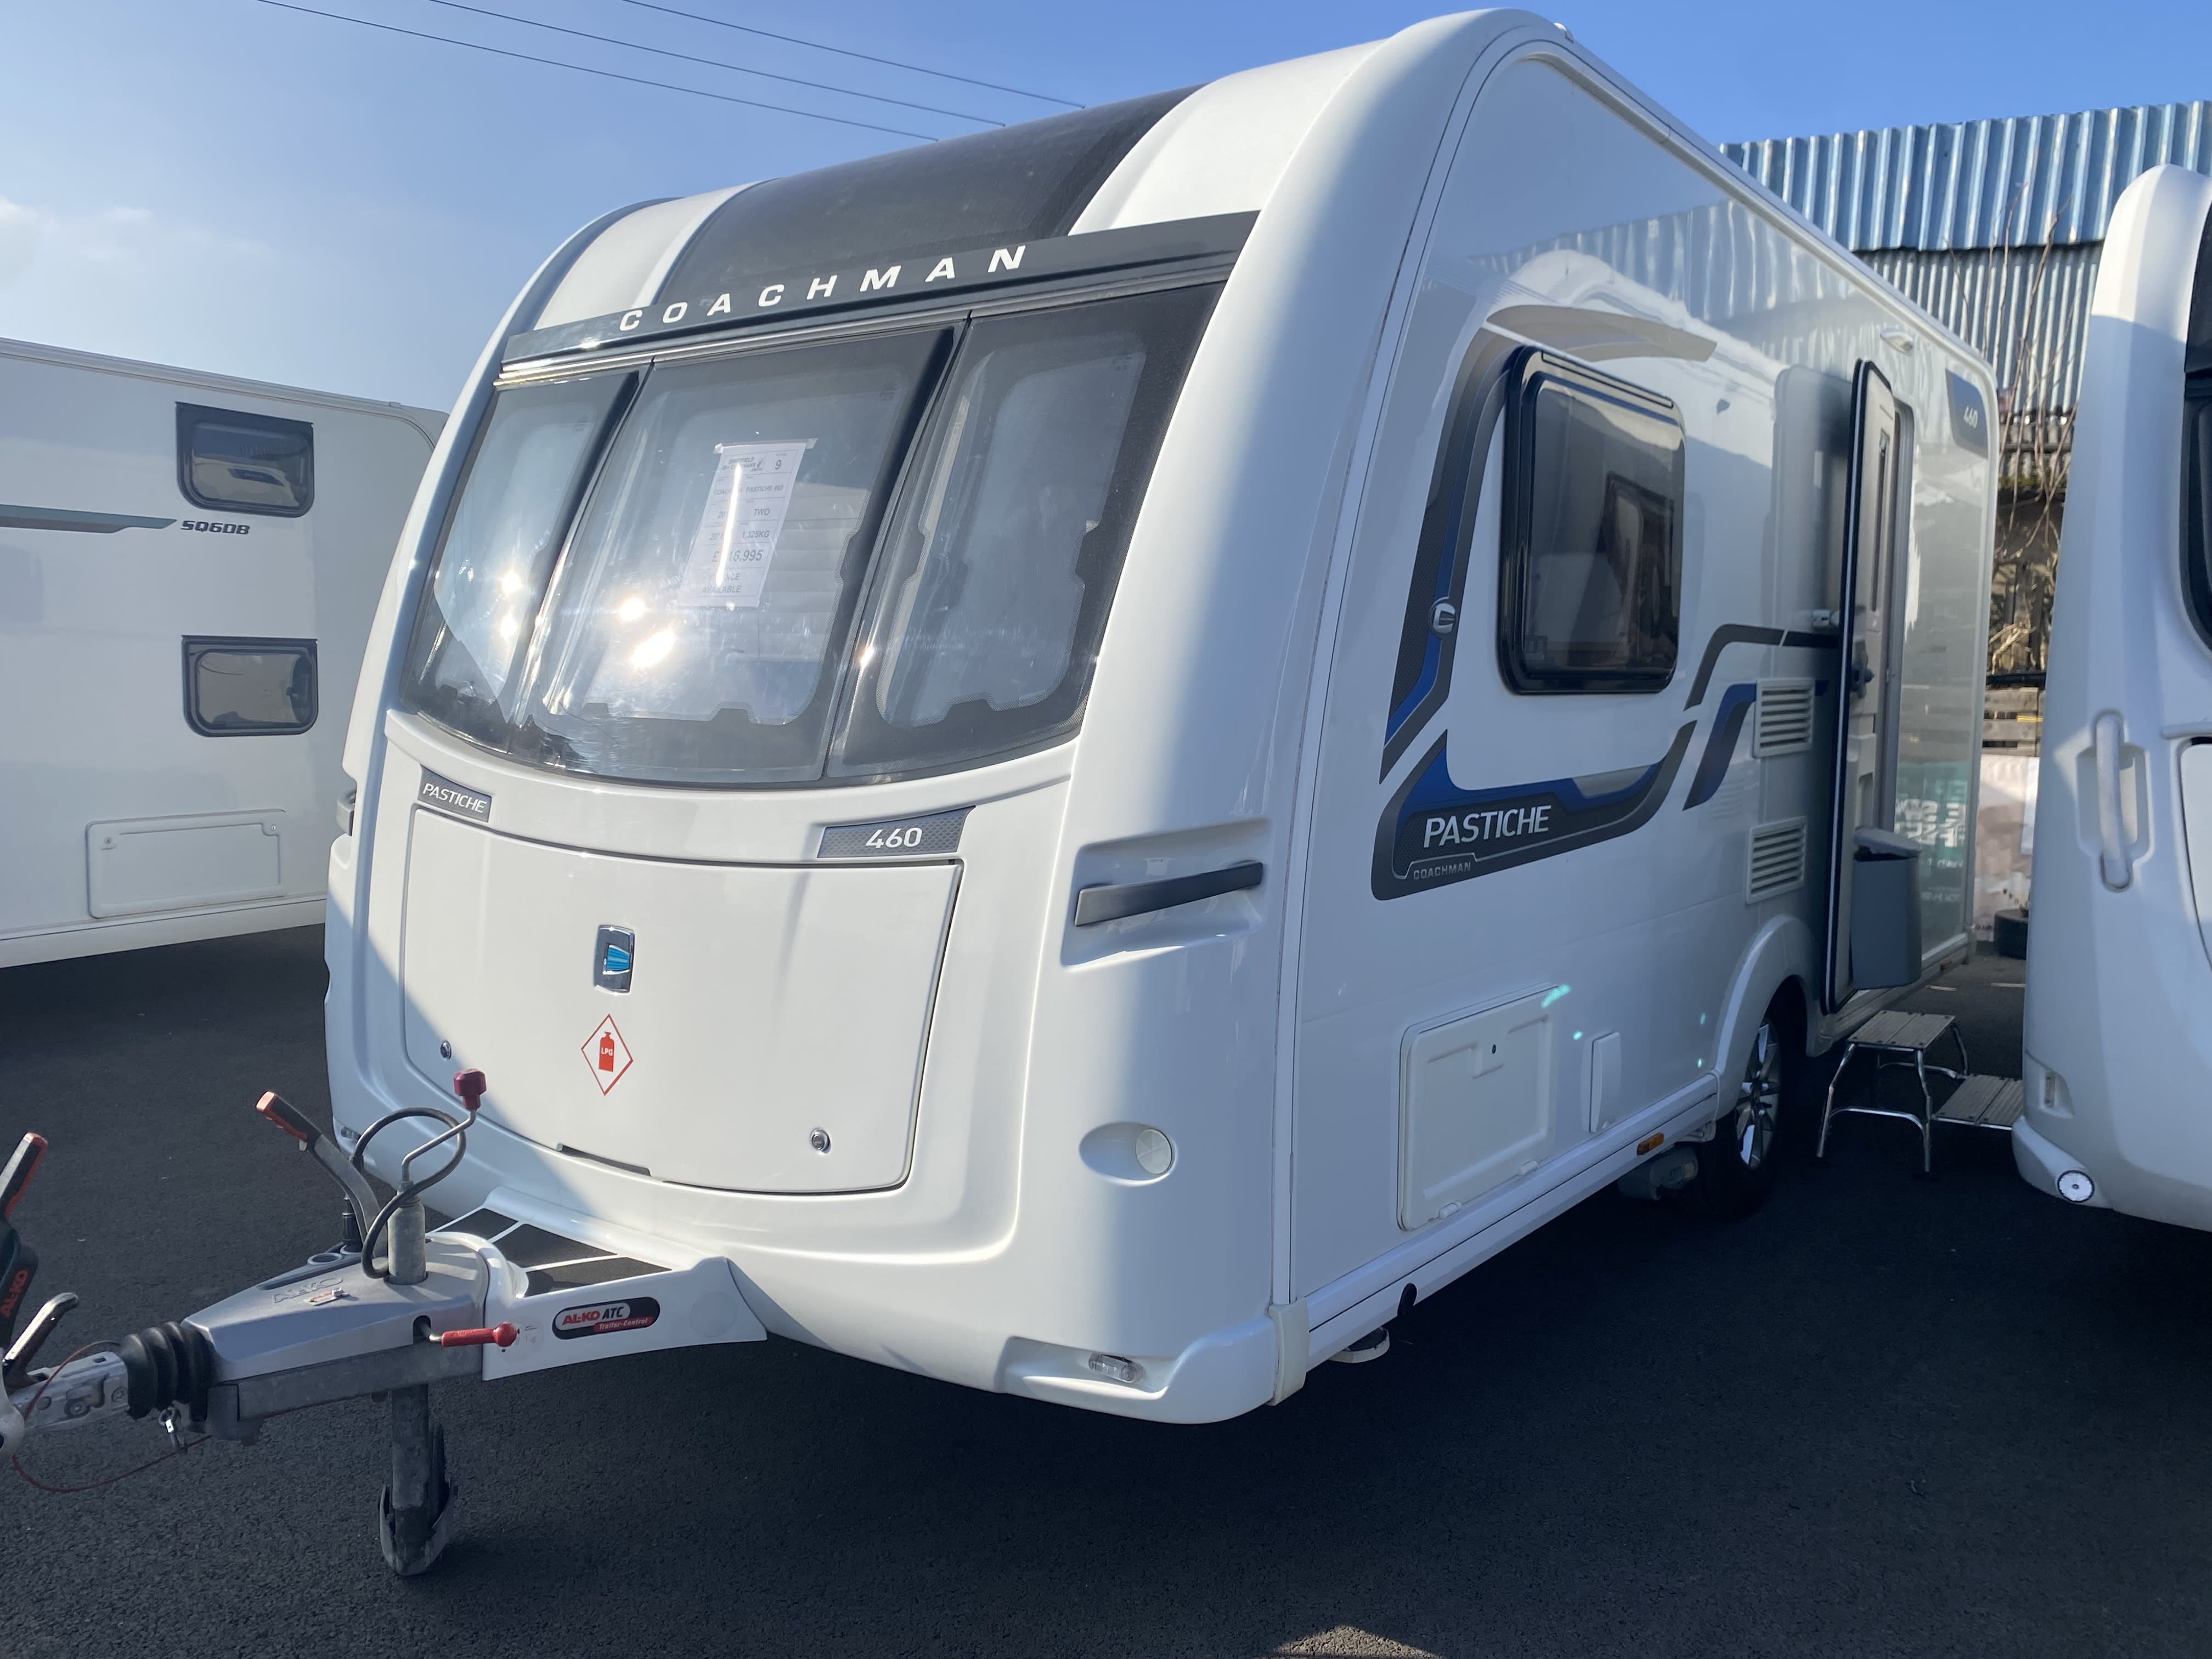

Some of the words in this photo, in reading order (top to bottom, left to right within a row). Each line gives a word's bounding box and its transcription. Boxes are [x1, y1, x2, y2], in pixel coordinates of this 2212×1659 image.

[620, 245, 1026, 331] COACHMAN
[1963, 405, 1978, 428] 460
[775, 459, 782, 470] 9
[754, 508, 770, 516] TWO
[180, 520, 250, 535] SQ6DB
[422, 783, 487, 813] PASTICHE
[1424, 805, 1552, 849] PASTICHE
[866, 827, 923, 848] 460
[1413, 862, 1471, 880] COACHMAN
[601, 1047, 613, 1056] LPG
[602, 1306, 624, 1320] ATC
